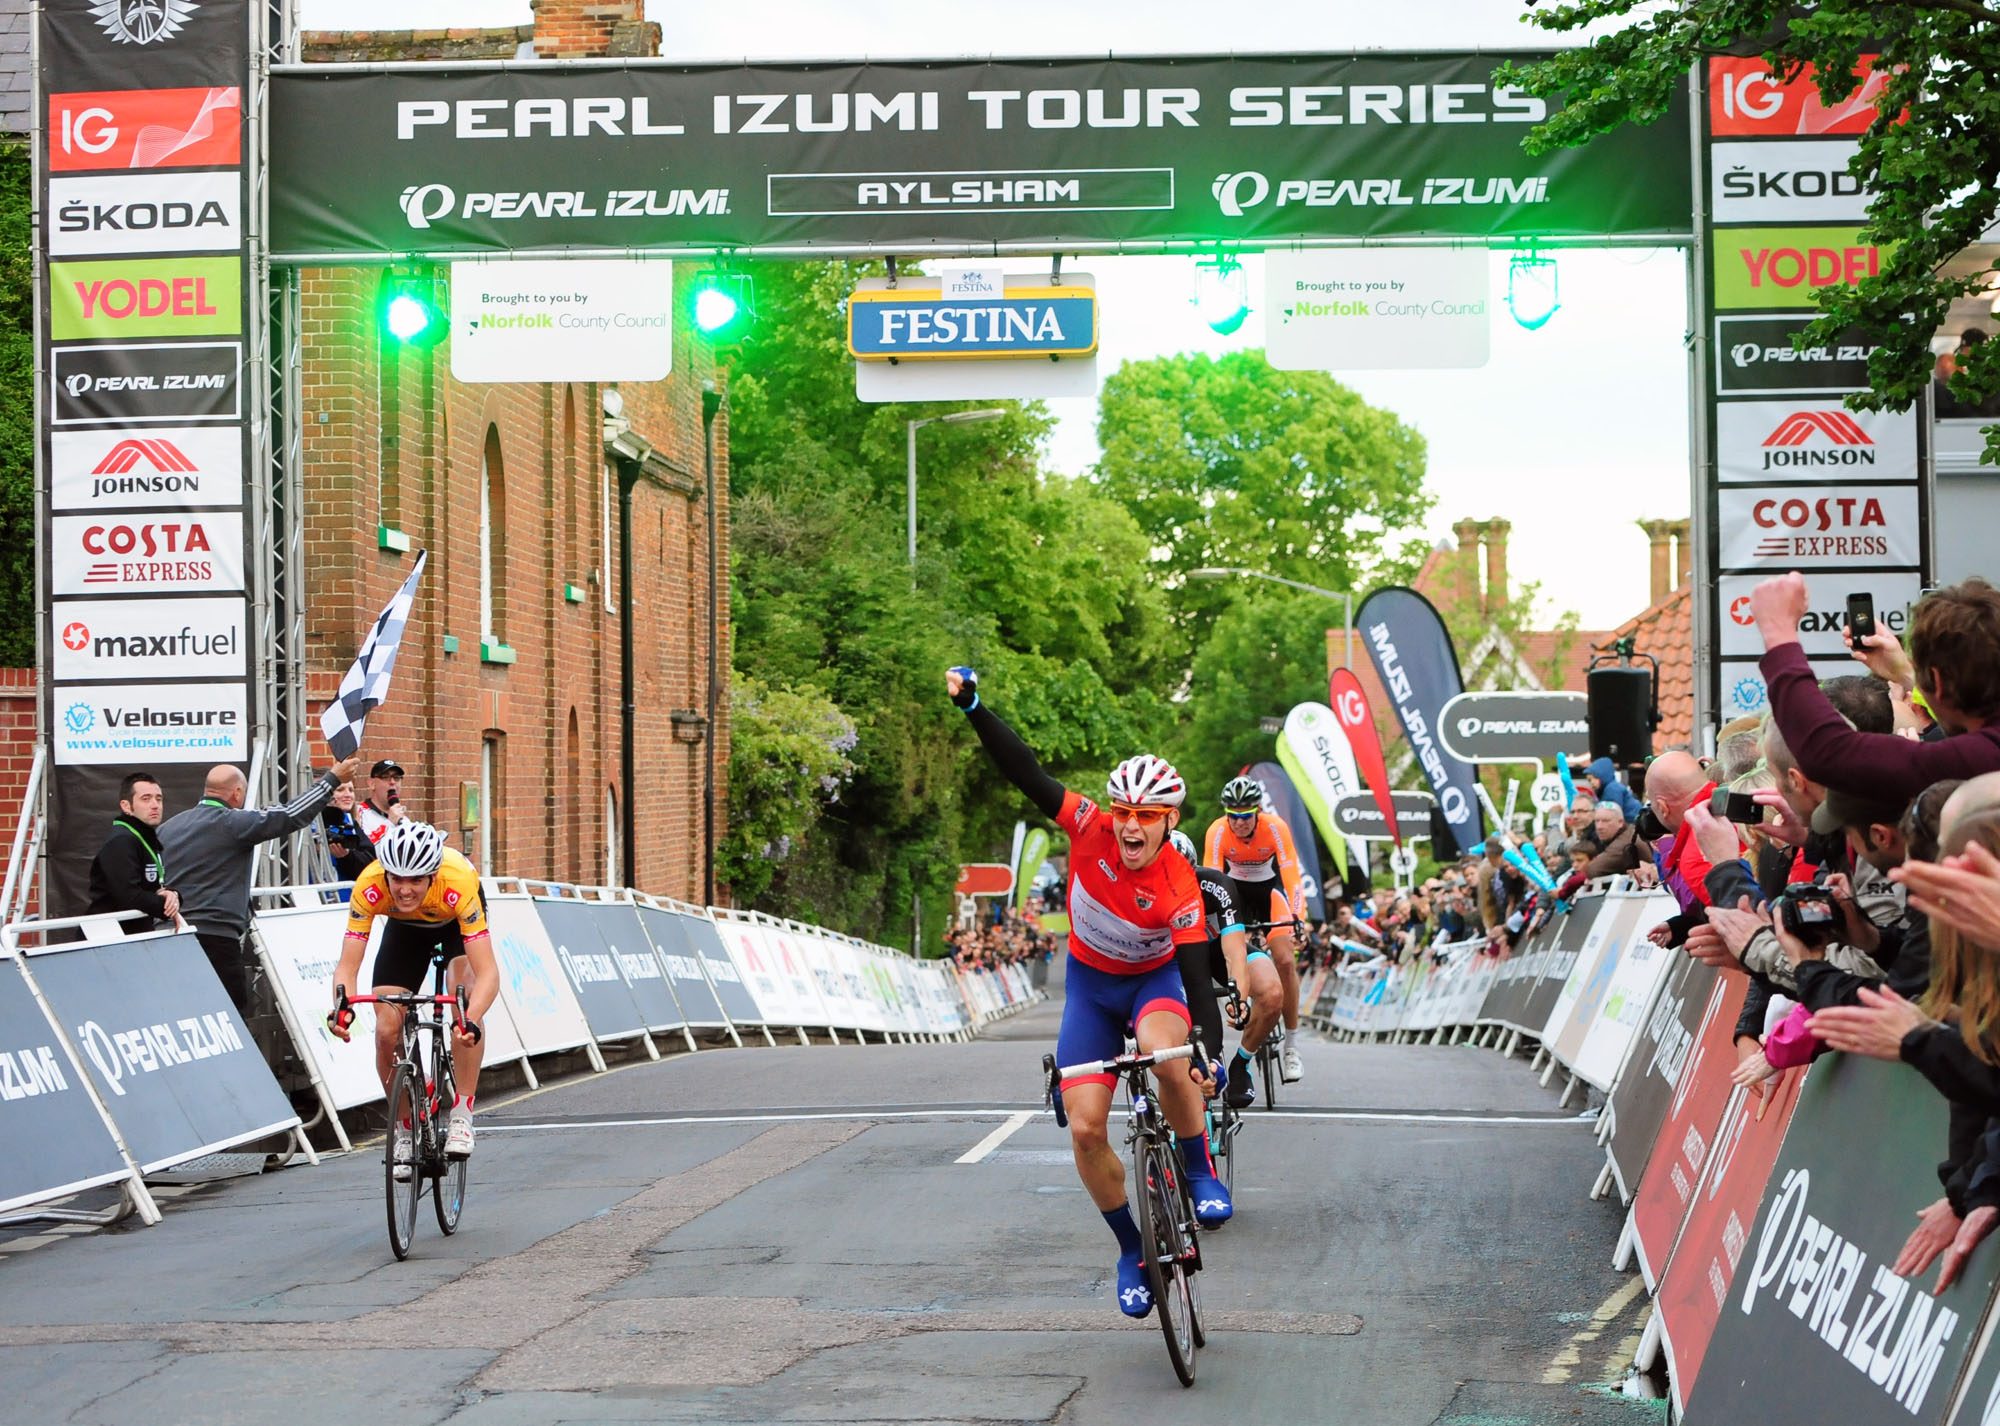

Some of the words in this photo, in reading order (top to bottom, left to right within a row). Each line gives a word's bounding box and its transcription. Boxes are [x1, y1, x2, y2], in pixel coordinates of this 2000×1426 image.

[1723, 71, 1784, 120] IG
[397, 96, 685, 140] PEARL
[713, 91, 939, 135] IZUMI
[968, 87, 1201, 130] TOUR
[1229, 83, 1547, 126] SERIES
[62, 107, 119, 155] IG
[857, 179, 1080, 205] AYLSHAM
[1276, 179, 1414, 207] PEARL
[1722, 166, 1882, 199] ŠKOD
[59, 200, 230, 232] ŠKODA
[461, 191, 598, 220] PEARL
[74, 277, 217, 319] YODEL
[481, 292, 530, 306] Brought
[533, 293, 546, 303] to
[549, 294, 571, 305] you
[574, 292, 589, 305] by
[951, 282, 993, 293] FESTINA
[1296, 280, 1345, 294] Brought
[1349, 281, 1362, 291] to
[1365, 282, 1387, 293] you
[1390, 280, 1405, 292] by
[481, 313, 554, 329] Norfolk
[558, 313, 611, 332] County
[613, 312, 667, 328] Council
[1296, 301, 1370, 317] Norfolk
[1375, 300, 1429, 319] County
[1431, 299, 1485, 315] Council
[879, 306, 1066, 345] FESTINA
[1763, 346, 1833, 363] PEARL
[94, 376, 160, 392] PEARL
[1763, 449, 1876, 471] JOHNSON
[92, 475, 199, 498] JOHNSON
[1753, 498, 1887, 532] COSTA
[82, 523, 212, 558] COSTA
[1794, 536, 1888, 557] EXPRESS
[122, 561, 213, 582] EXPRESS
[94, 625, 236, 658] maxifuel
[103, 707, 237, 728] Velosure
[1337, 690, 1365, 727] IG
[1483, 720, 1538, 734] PEARL
[66, 735, 234, 750] www.velosure.co.uk
[1541, 785, 1561, 802] 25
[364, 887, 379, 904] IG
[1200, 879, 1233, 909] GENESIS
[113, 1023, 193, 1076] PEARL
[0, 1046, 69, 1101] ZUMi
[1775, 1214, 1868, 1352] PEARL
